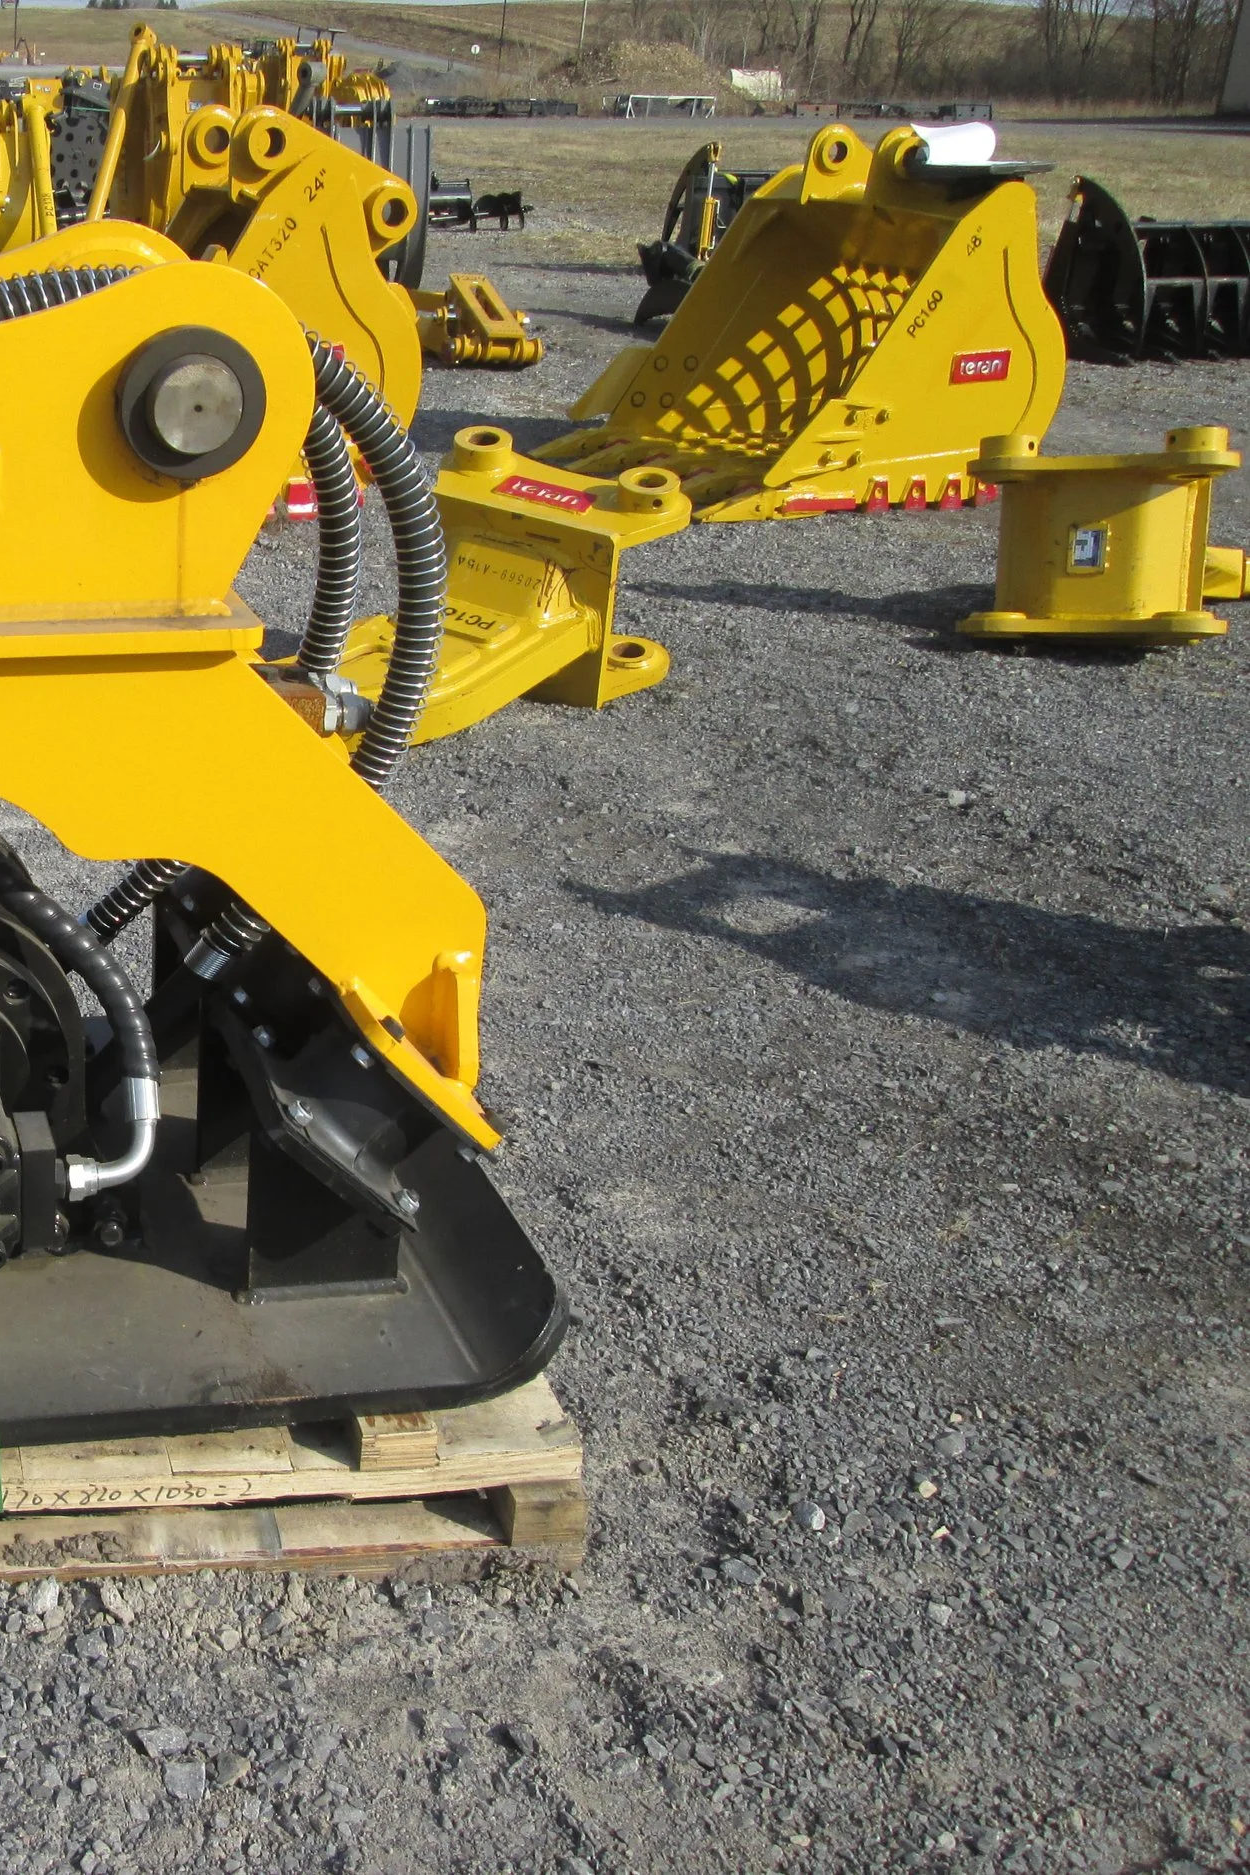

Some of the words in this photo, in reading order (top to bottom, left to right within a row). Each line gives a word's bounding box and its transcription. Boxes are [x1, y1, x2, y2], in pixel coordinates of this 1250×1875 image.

[247, 217, 297, 280] CAT320
[906, 289, 944, 339] PC160
[959, 357, 1003, 376] teran
[512, 480, 579, 505] teran
